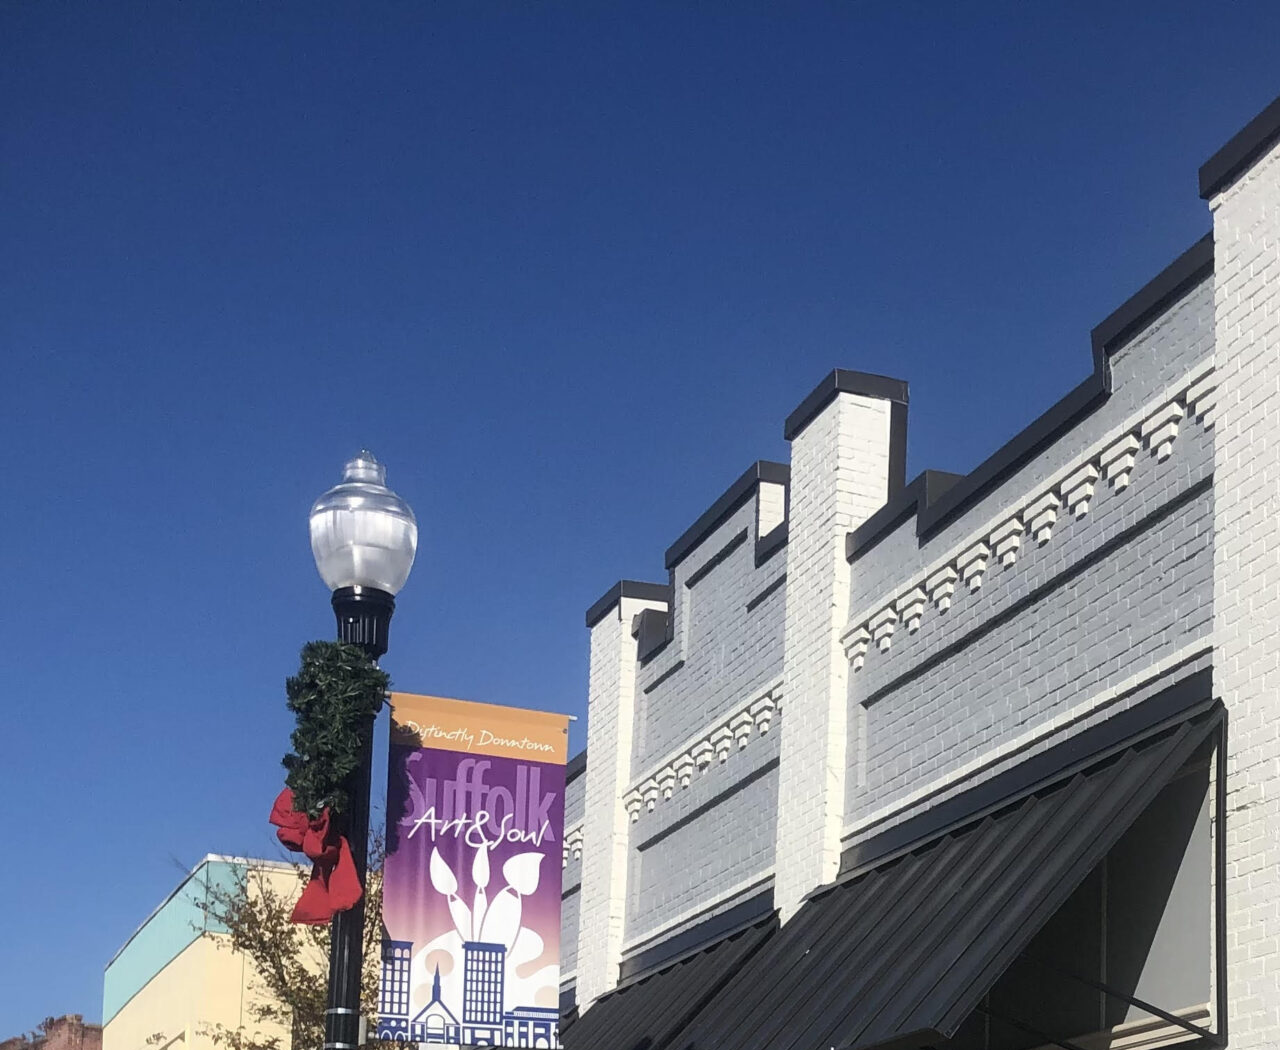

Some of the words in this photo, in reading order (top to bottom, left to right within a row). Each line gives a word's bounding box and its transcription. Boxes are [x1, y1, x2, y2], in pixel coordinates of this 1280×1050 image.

[406, 720, 474, 749] Distinctly
[476, 729, 555, 752] Downtown
[399, 751, 557, 842] Suffolk
